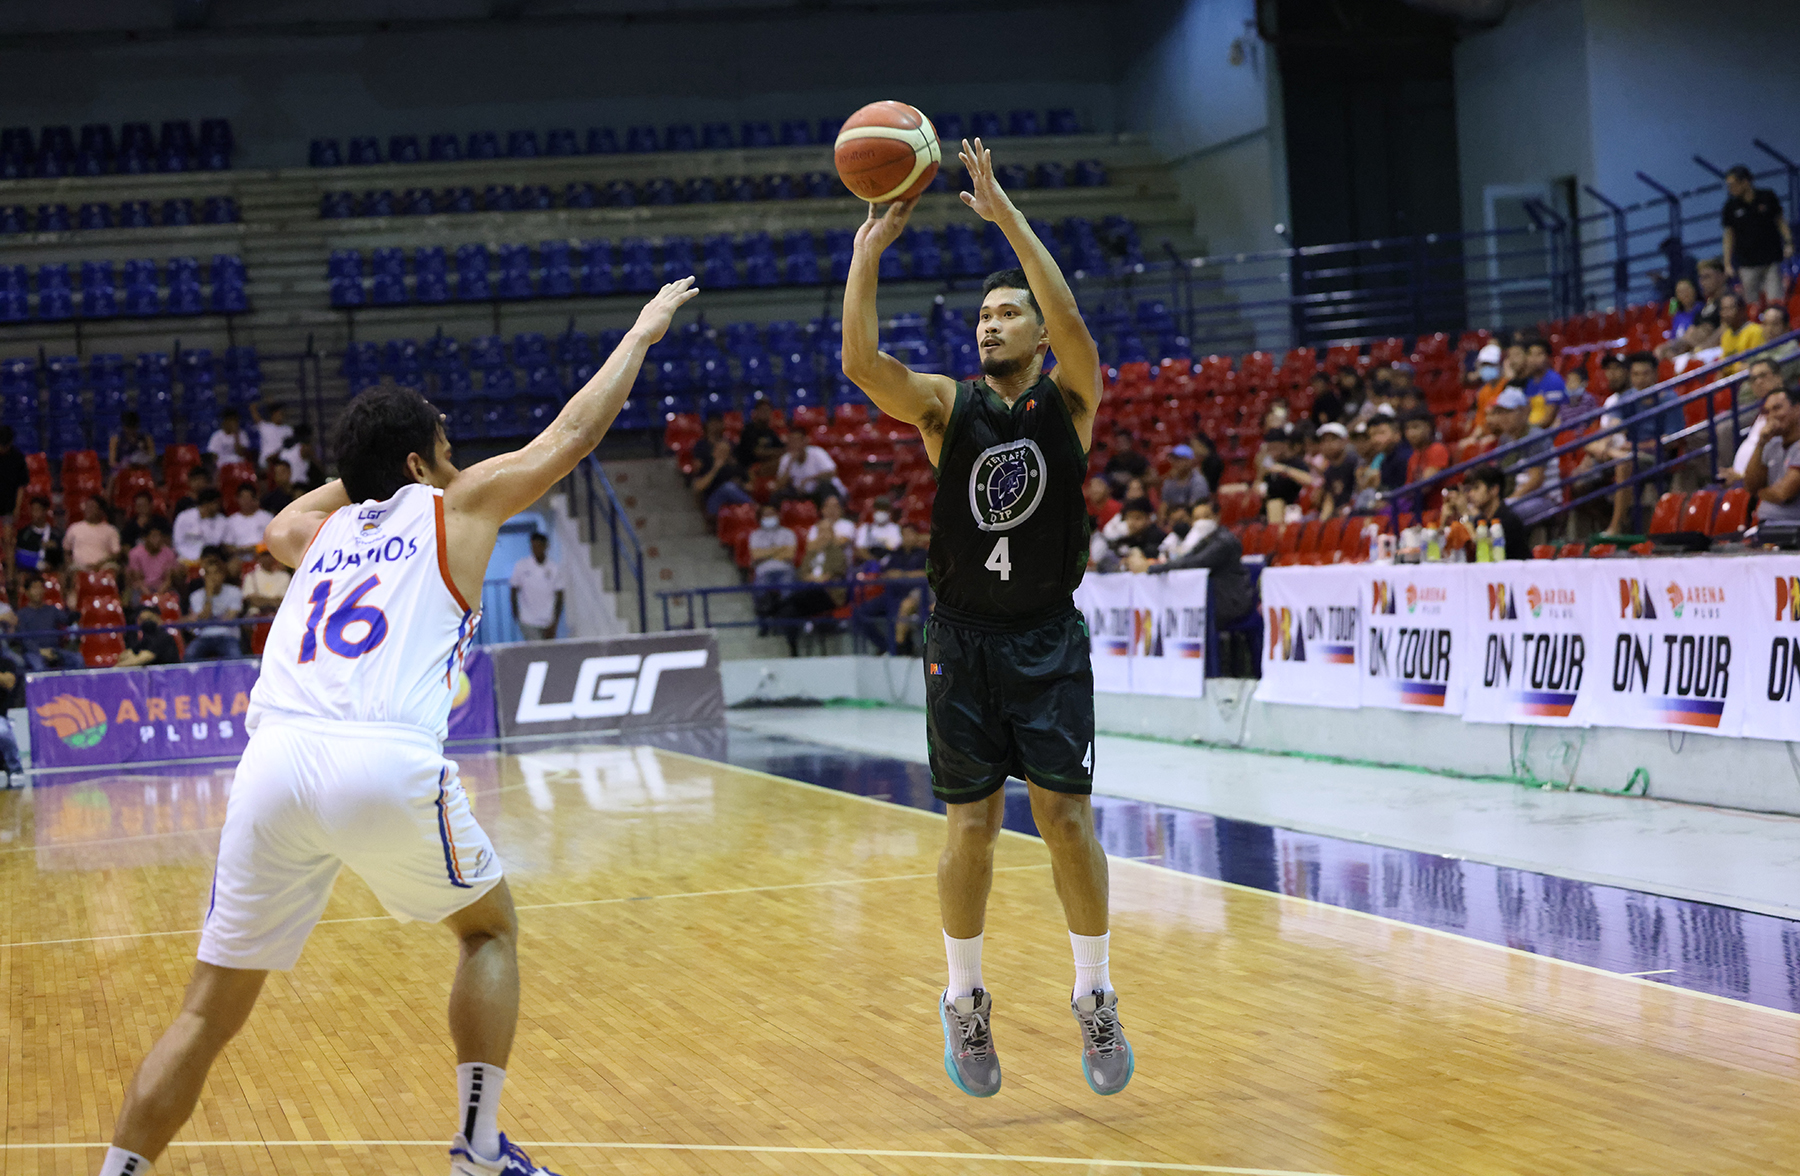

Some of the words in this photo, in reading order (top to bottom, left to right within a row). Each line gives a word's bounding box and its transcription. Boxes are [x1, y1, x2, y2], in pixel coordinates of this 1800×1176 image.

[984, 536, 1012, 581] 4
[1686, 586, 1725, 604] ARENA
[1693, 606, 1720, 618] PLUS
[297, 573, 389, 665] 16
[1396, 627, 1451, 682] TOUR
[1484, 632, 1515, 688] ON
[1521, 632, 1585, 692] TOUR
[1613, 633, 1653, 694] ON
[1662, 634, 1731, 699] TOUR
[115, 690, 250, 724] ARENA
[140, 720, 234, 744] PLUS
[1081, 741, 1092, 775] 4
